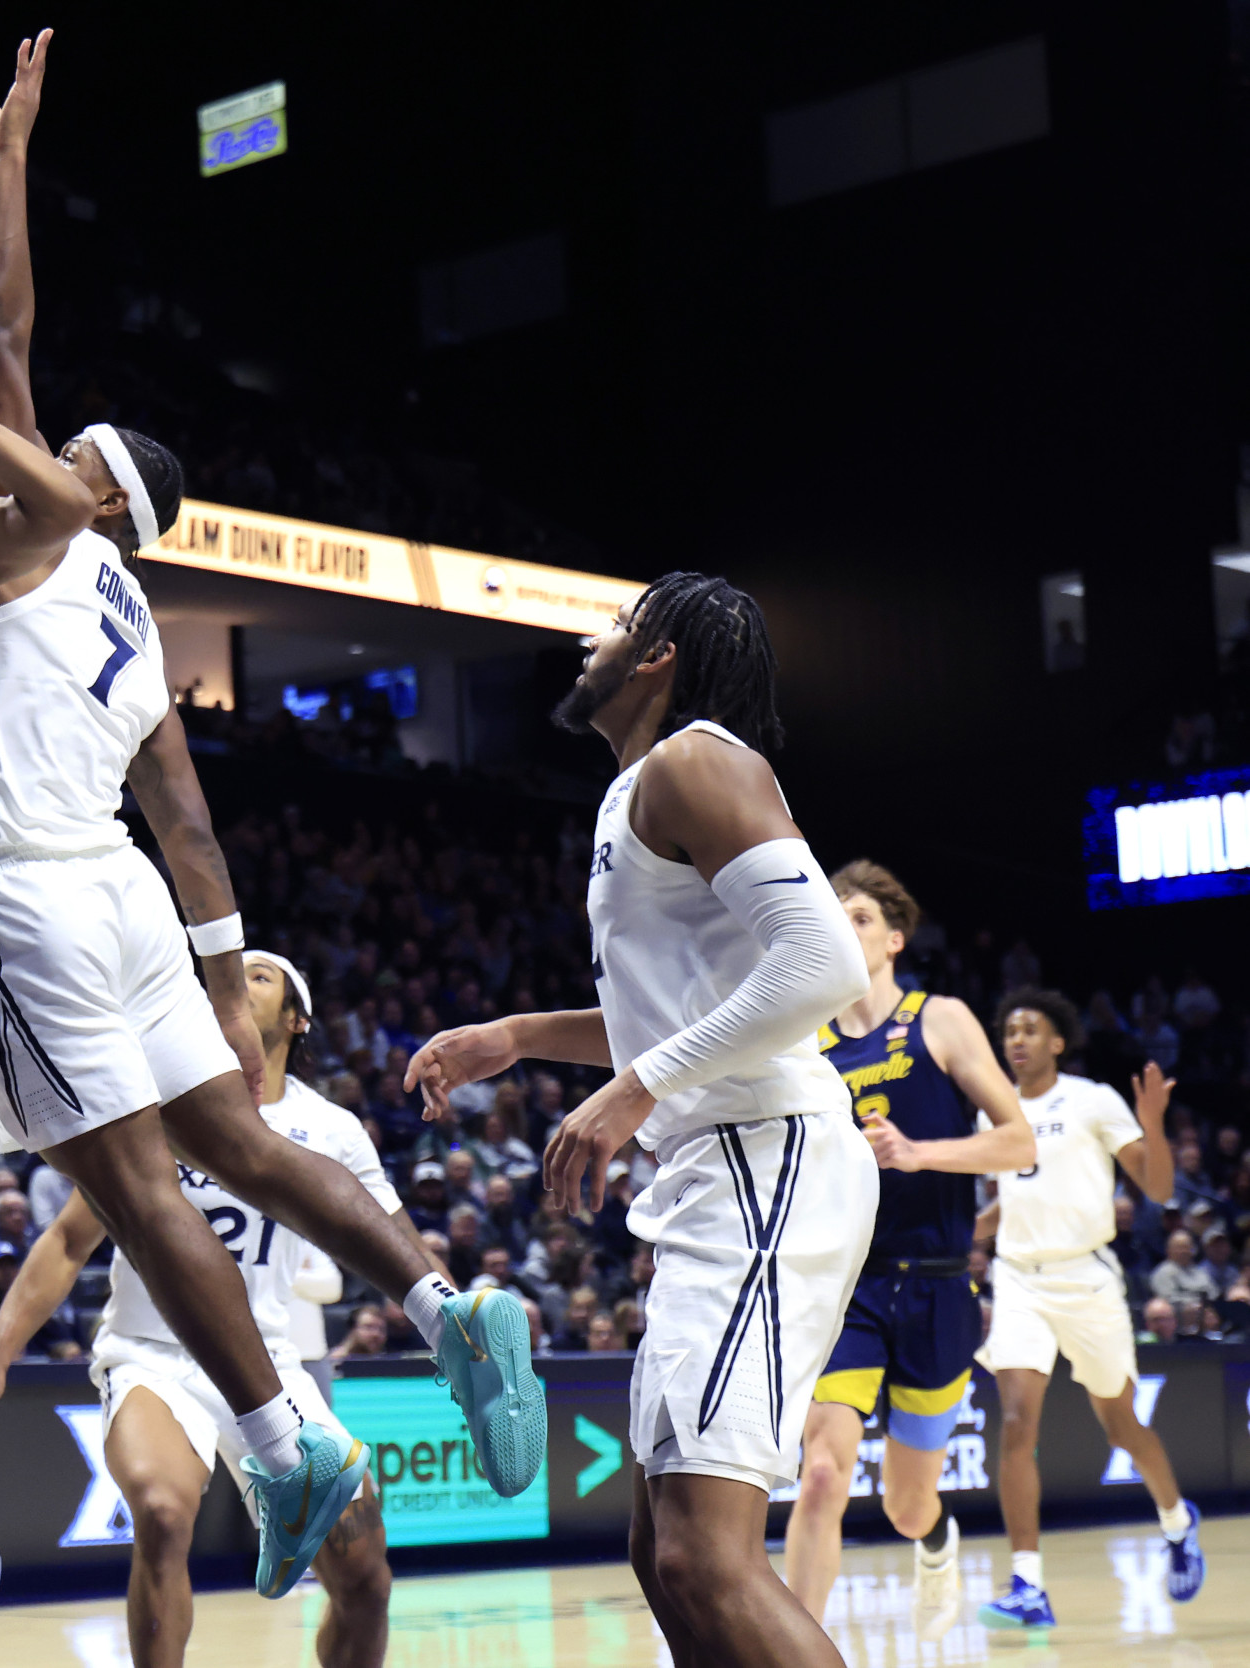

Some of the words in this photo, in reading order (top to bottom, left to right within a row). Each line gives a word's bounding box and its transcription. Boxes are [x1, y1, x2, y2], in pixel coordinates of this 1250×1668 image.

[230, 523, 288, 569] DUNK
[295, 537, 370, 584] FLAVOR
[87, 610, 138, 708] 7
[203, 1206, 278, 1266] 21
